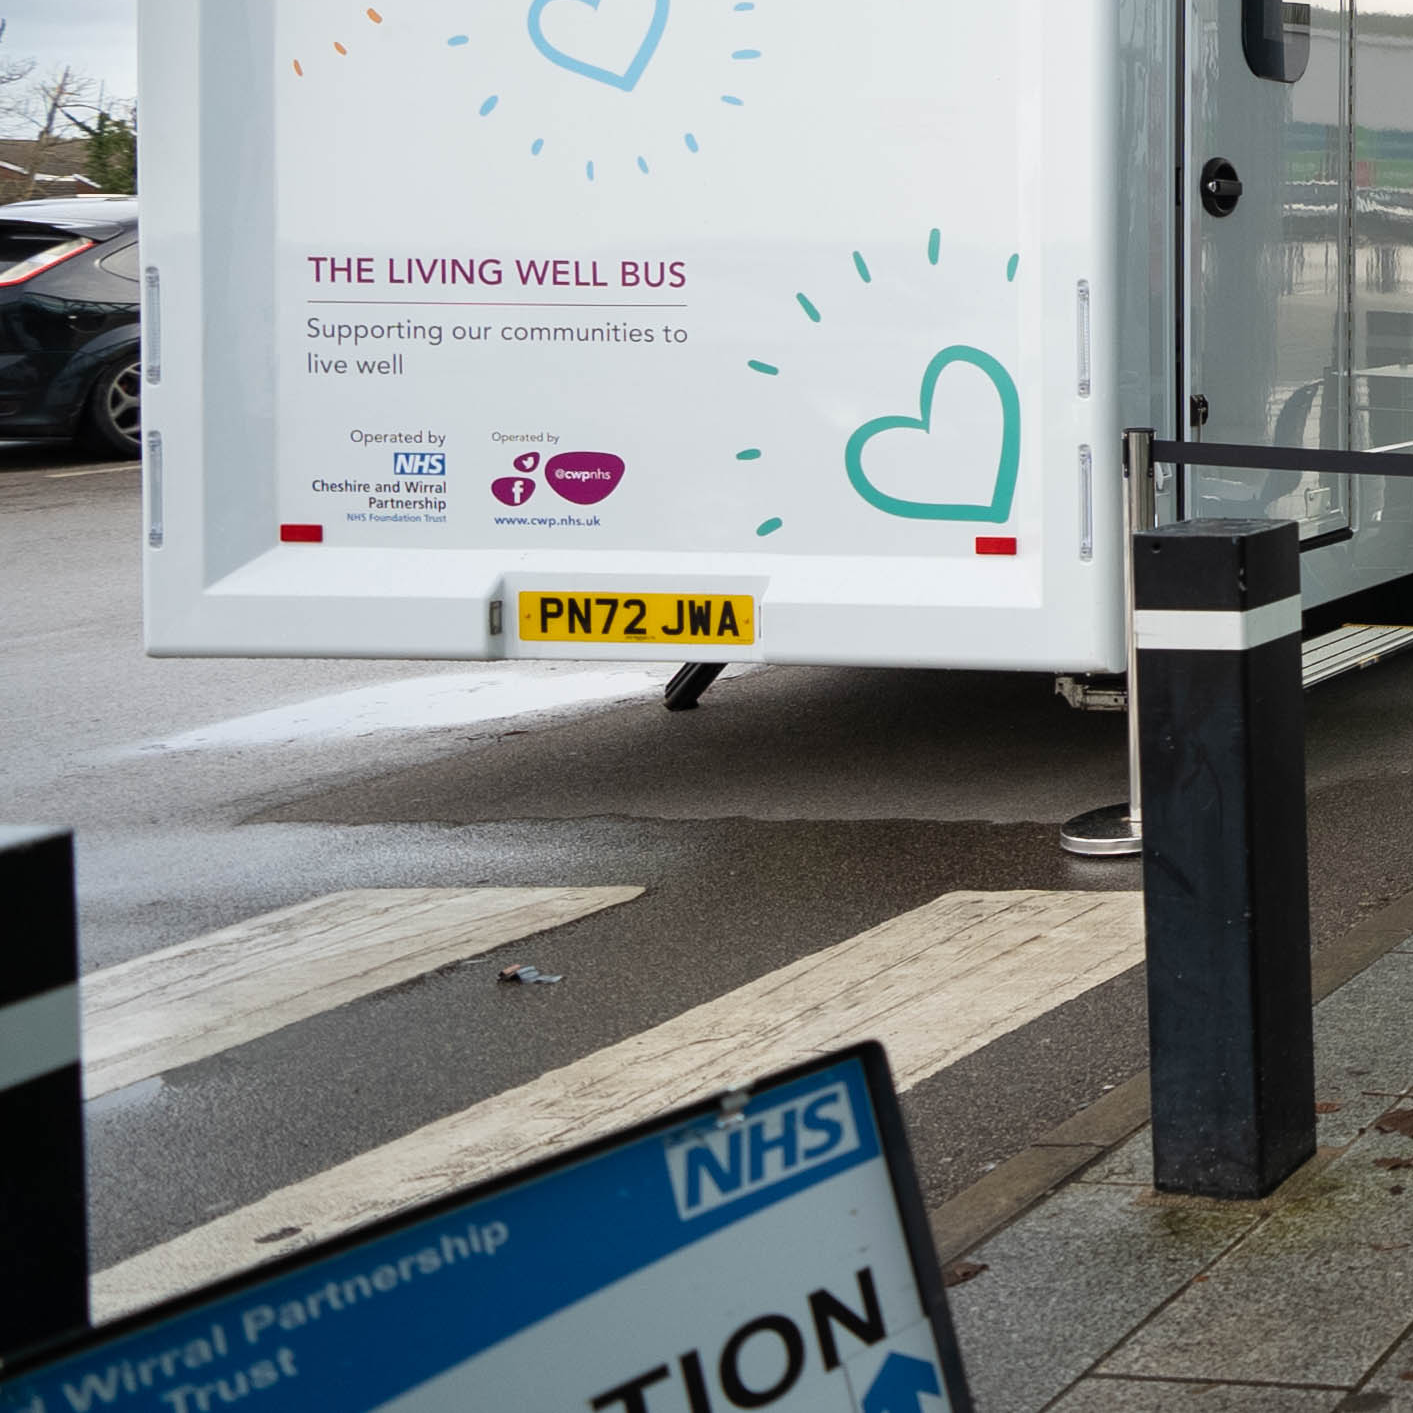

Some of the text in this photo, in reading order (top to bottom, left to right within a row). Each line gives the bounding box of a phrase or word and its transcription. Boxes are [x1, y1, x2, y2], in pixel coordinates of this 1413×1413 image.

[308, 257, 686, 287] THE LIVING WELL BUS
[307, 317, 688, 346] Supporting our communities to
[307, 353, 403, 375] live well
[350, 430, 446, 447] Operated by
[491, 432, 560, 444] Operated by
[395, 454, 444, 475] NHS
[554, 468, 611, 482] @cwpnhs
[312, 480, 447, 494] Cheshire and Wirral
[368, 497, 447, 511] Partnership
[347, 513, 447, 523] NHS Foundation Trust
[494, 515, 601, 528] www.cwp.nhs.uk
[540, 597, 740, 637] PN72 JWA
[684, 1091, 844, 1212] NHS
[62, 1220, 509, 1413] Wirral Partnership
[161, 1345, 298, 1413] Trust
